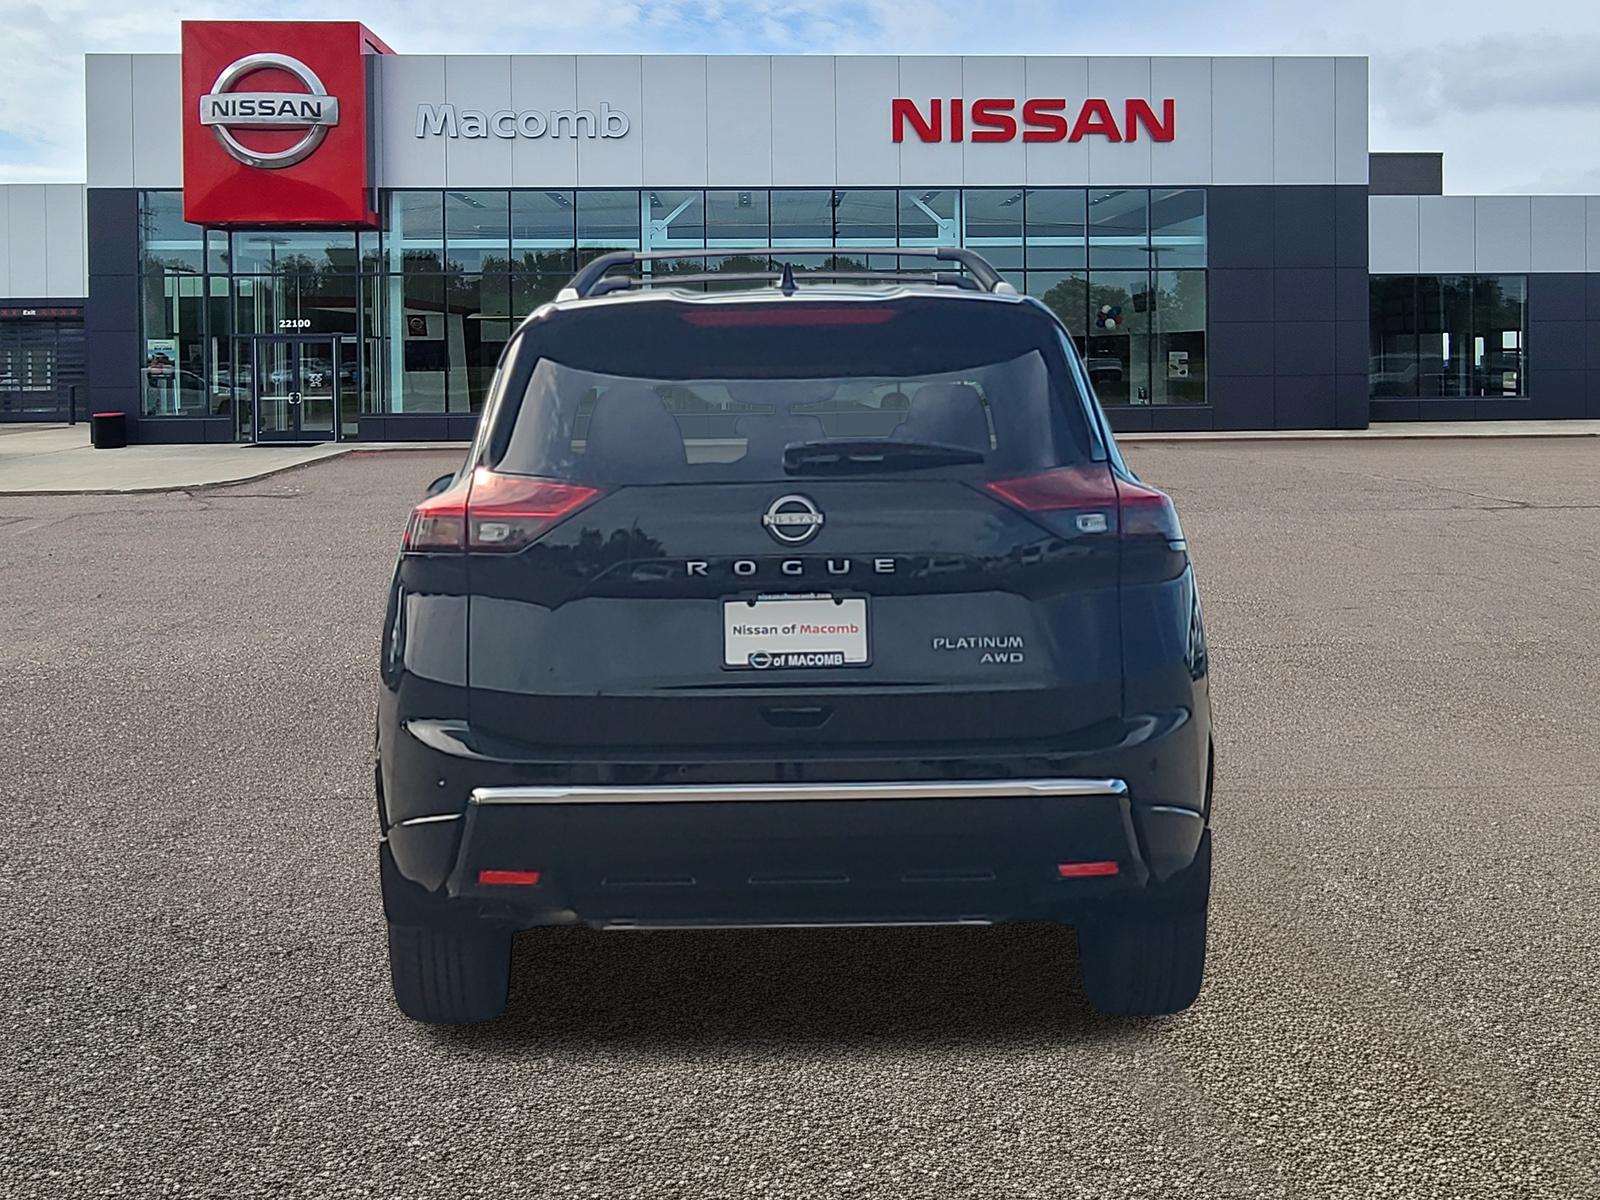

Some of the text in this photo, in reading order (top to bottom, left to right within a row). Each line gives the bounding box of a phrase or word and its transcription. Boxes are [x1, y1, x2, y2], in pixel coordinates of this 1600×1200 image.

[212, 100, 321, 117] NISSAN
[415, 102, 630, 139] Macomb
[891, 98, 1175, 143] NISSAN
[279, 319, 311, 328] 22100
[764, 513, 823, 525] NISSAN
[686, 558, 896, 576] ROGUE
[732, 623, 859, 636] Nissan of Macomb
[933, 636, 1024, 649] PLATINUM
[773, 655, 786, 666] of
[788, 654, 843, 666] MACOMB
[980, 652, 1024, 664] AWD
